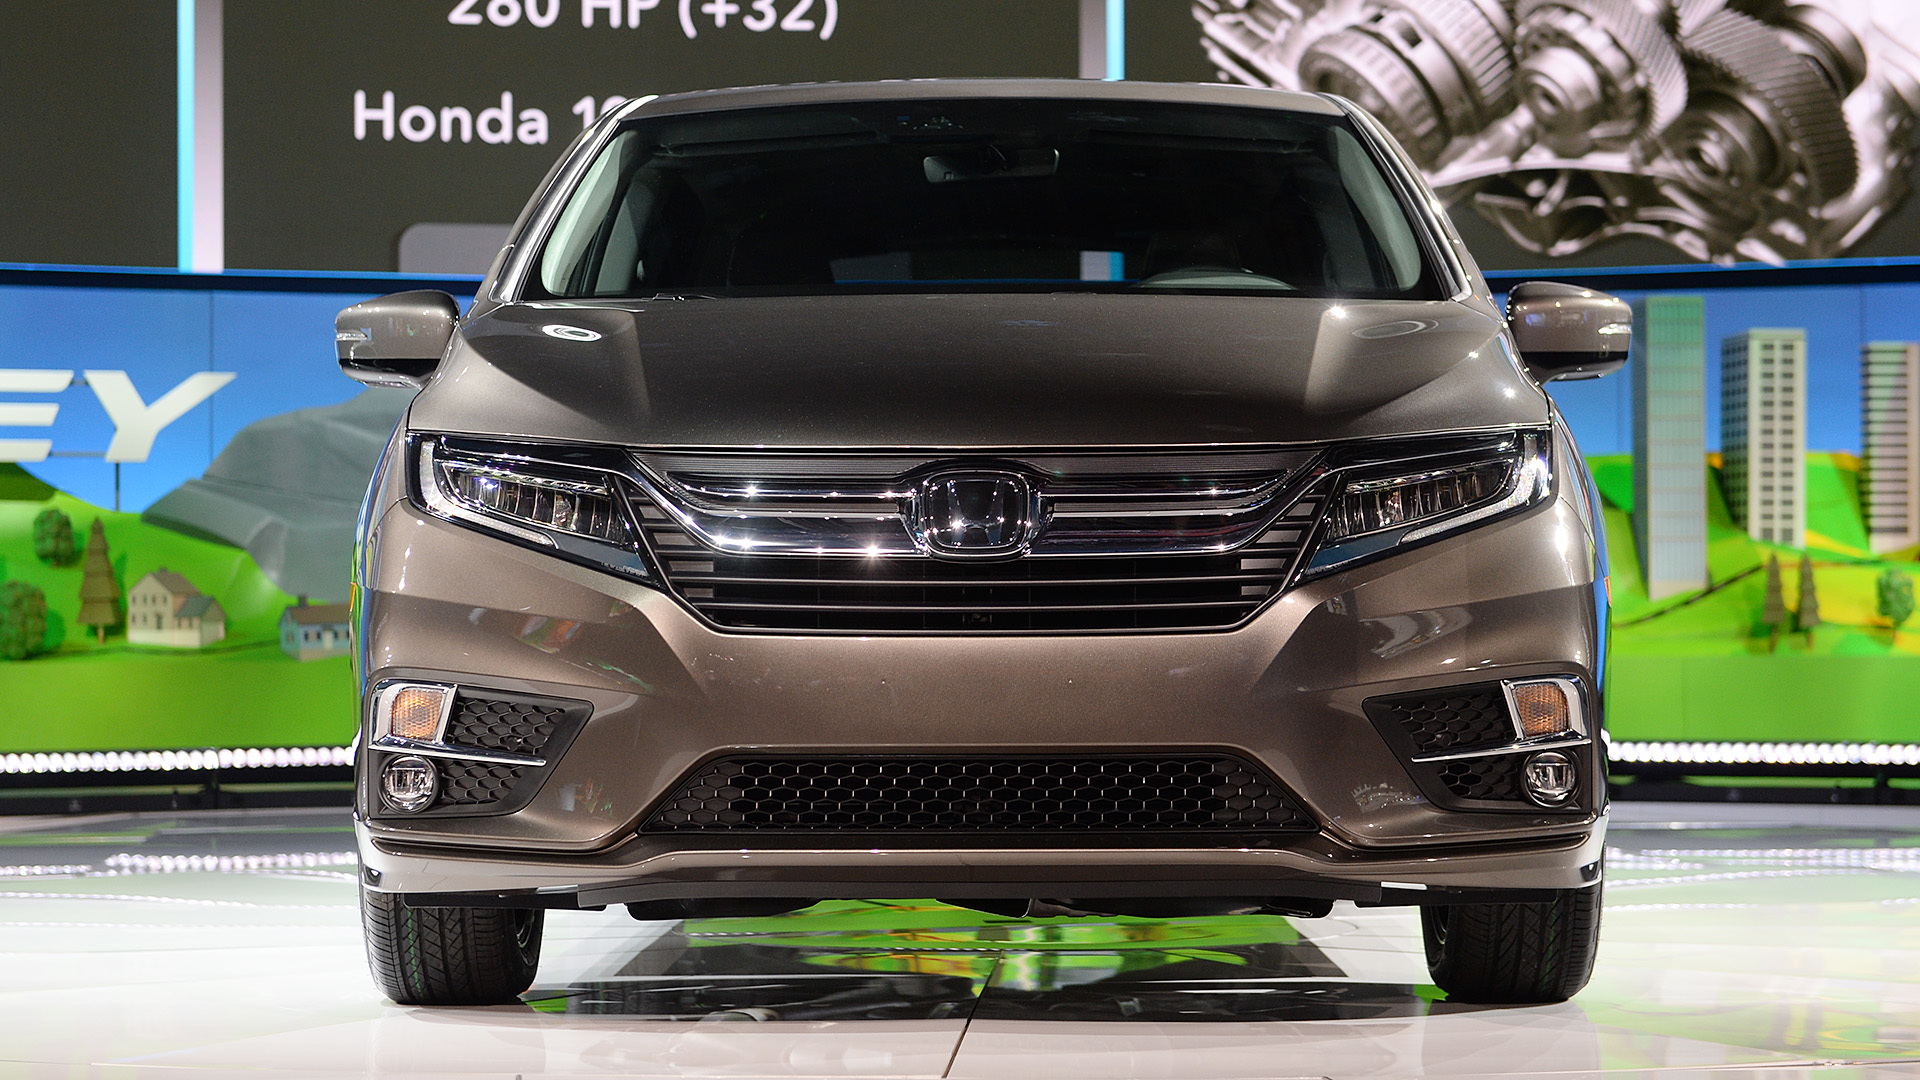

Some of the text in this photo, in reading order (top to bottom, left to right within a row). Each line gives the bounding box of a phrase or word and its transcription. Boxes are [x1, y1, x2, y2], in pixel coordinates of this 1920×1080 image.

[581, 0, 662, 29] HP
[678, 0, 839, 41] (+32)
[353, 89, 549, 145] Honda
